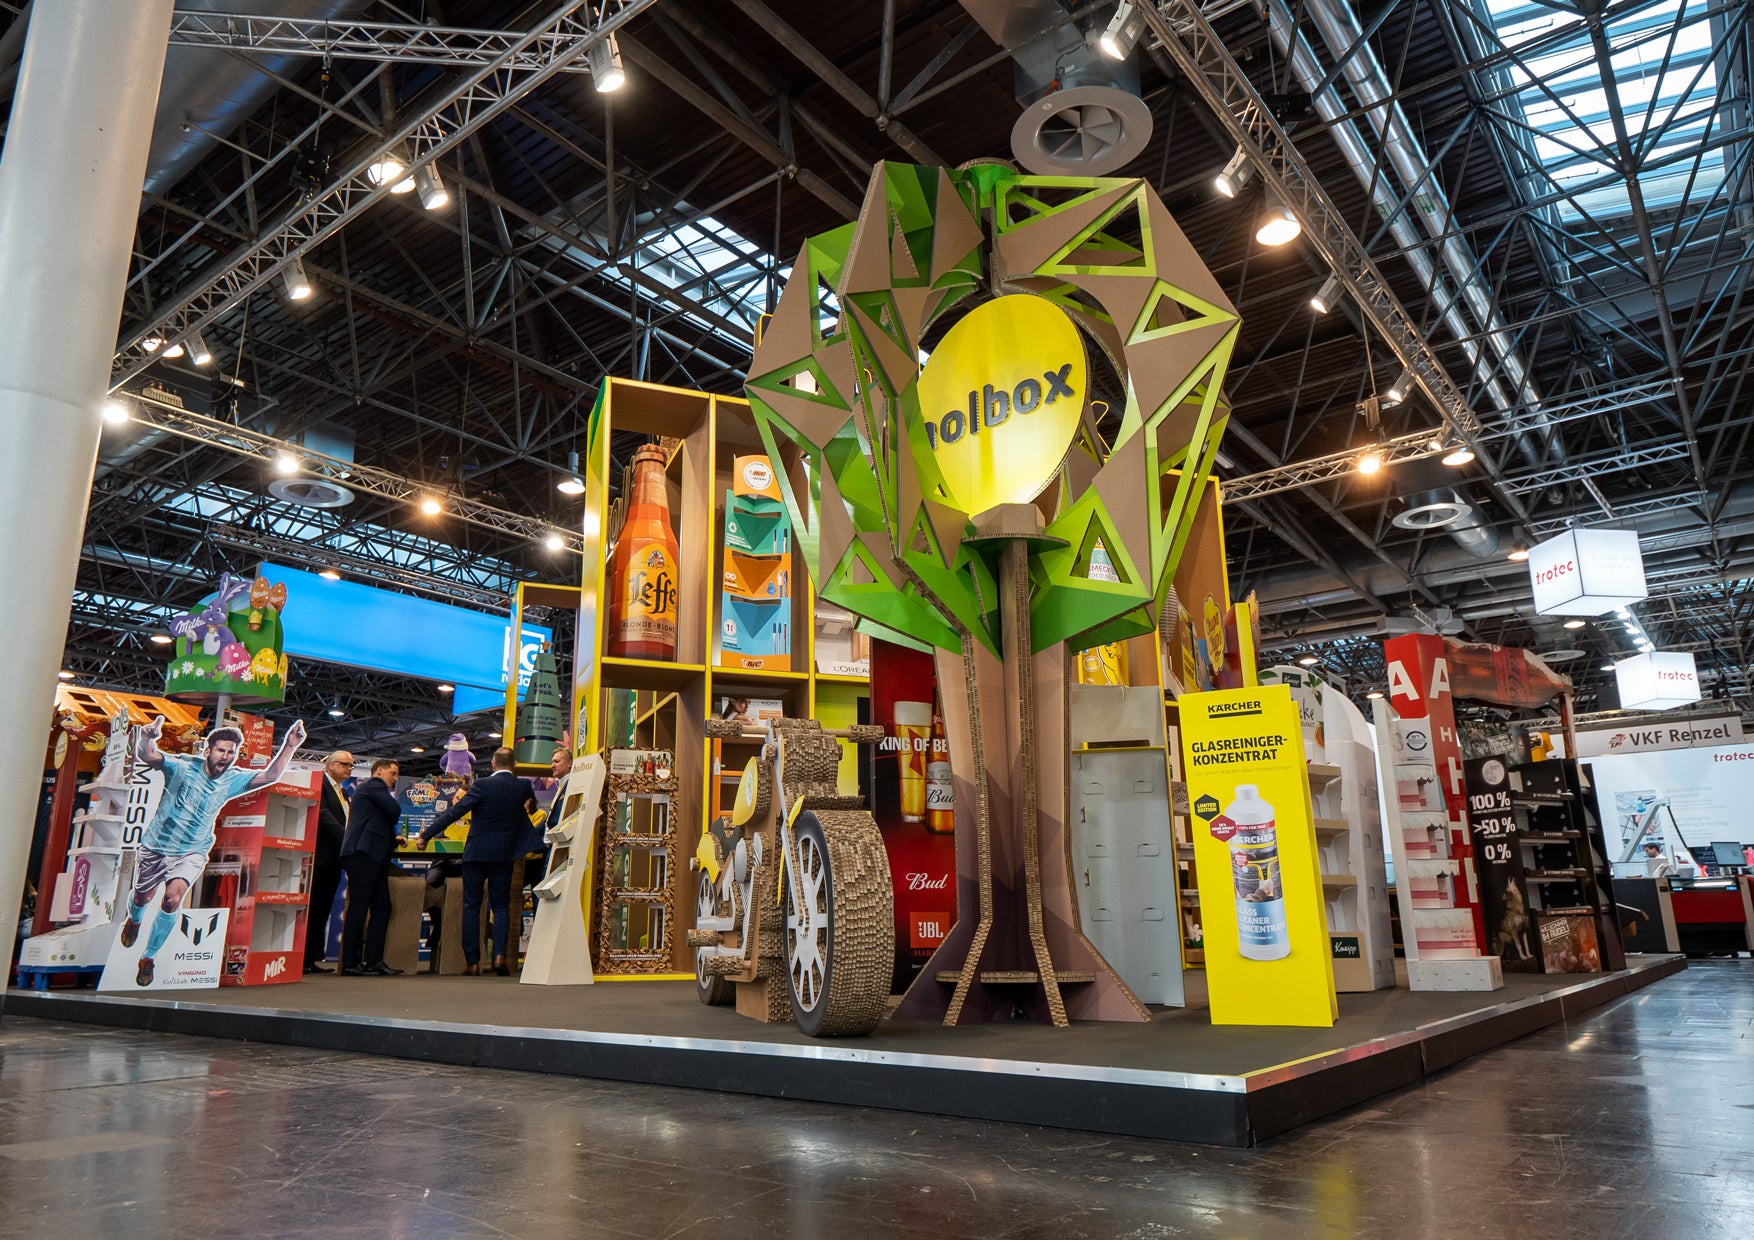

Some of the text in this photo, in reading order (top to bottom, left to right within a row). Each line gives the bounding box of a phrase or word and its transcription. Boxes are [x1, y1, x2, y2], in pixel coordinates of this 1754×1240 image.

[1535, 560, 1574, 585] trotec
[628, 571, 677, 614] Leffe
[175, 616, 206, 634] Milka
[622, 621, 652, 629] BLONDE
[225, 661, 250, 673] Milka
[747, 660, 762, 668] BIC
[833, 665, 869, 674] L'OREA
[1658, 670, 1693, 681] trotec
[533, 681, 552, 689] Let's
[1207, 700, 1262, 713] KÄRCHER
[1629, 723, 1731, 746] VKF Renzel
[880, 736, 948, 752] KING OF BE
[1191, 734, 1288, 753] GLASREINIGER-
[1193, 748, 1278, 767] KONZENTRAT
[1713, 752, 1754, 762] trotec
[407, 789, 440, 798] FAMILY
[1469, 791, 1511, 810] 100 %
[1472, 816, 1516, 834] >50 %
[1484, 843, 1512, 860] 0 %
[905, 873, 949, 890] Bud
[1239, 915, 1270, 924] CLEANER
[918, 921, 944, 938] JBL
[1334, 941, 1357, 955] Kneipp
